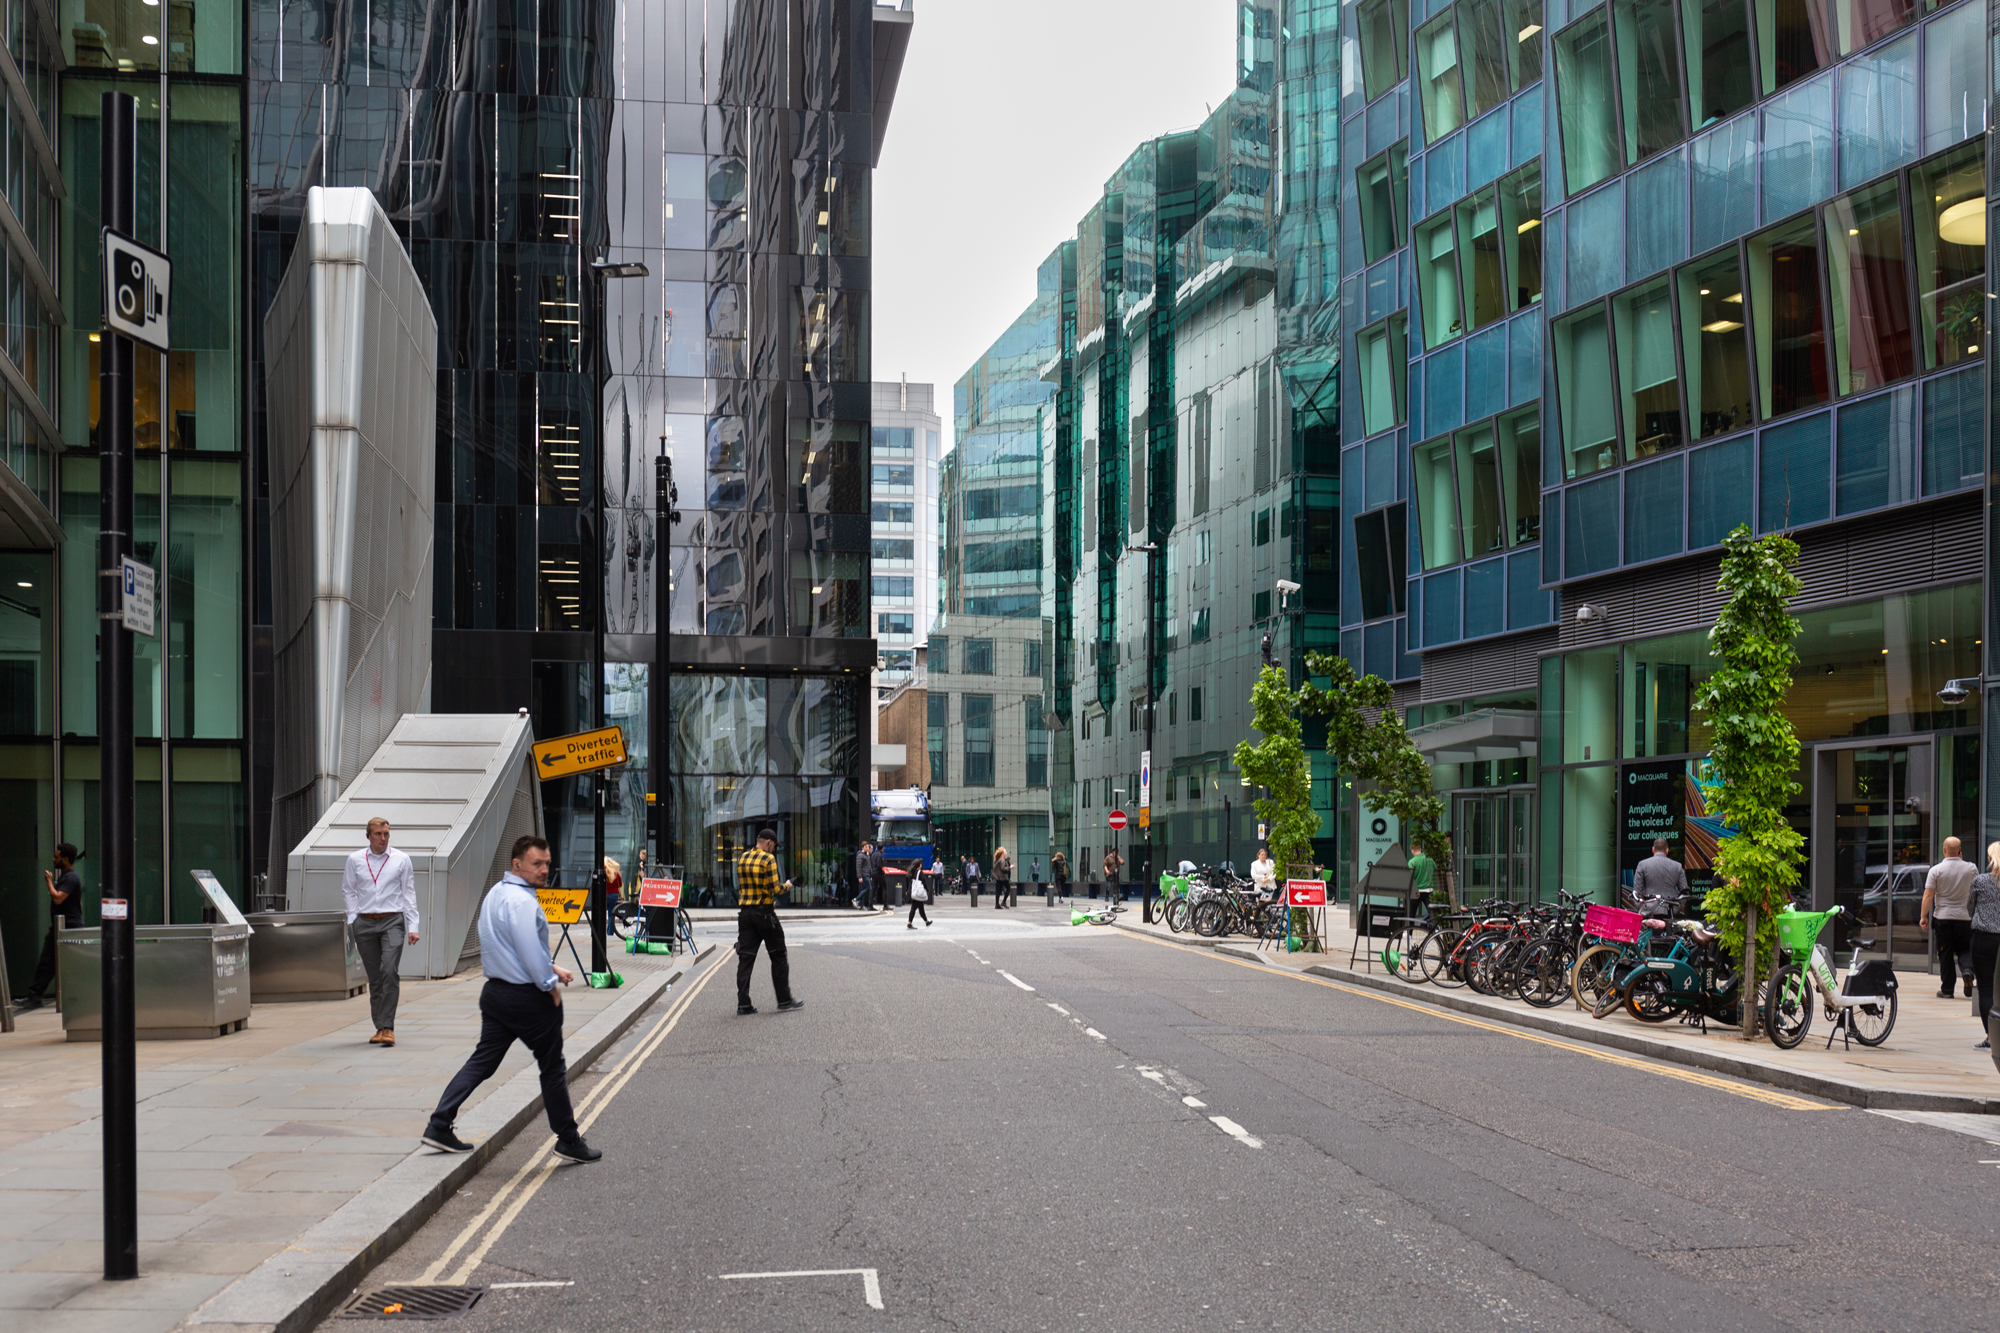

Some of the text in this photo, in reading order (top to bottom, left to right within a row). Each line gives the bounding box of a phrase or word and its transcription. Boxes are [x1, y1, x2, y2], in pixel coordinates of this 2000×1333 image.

[126, 567, 133, 592] P
[145, 582, 153, 593] only
[136, 593, 152, 606] 30 mins
[130, 603, 149, 617] No return
[127, 617, 139, 627] within
[143, 621, 151, 631] hour
[567, 734, 618, 753] Diverted
[577, 749, 615, 764] traffic
[1638, 772, 1668, 781] MACQUARIE
[1628, 803, 1667, 816] Amplifying
[1628, 815, 1674, 827] the voices of
[1628, 829, 1679, 840] our colleagues
[1375, 847, 1383, 855] 28
[544, 906, 557, 916] ffic
[1706, 967, 1714, 990] forest
